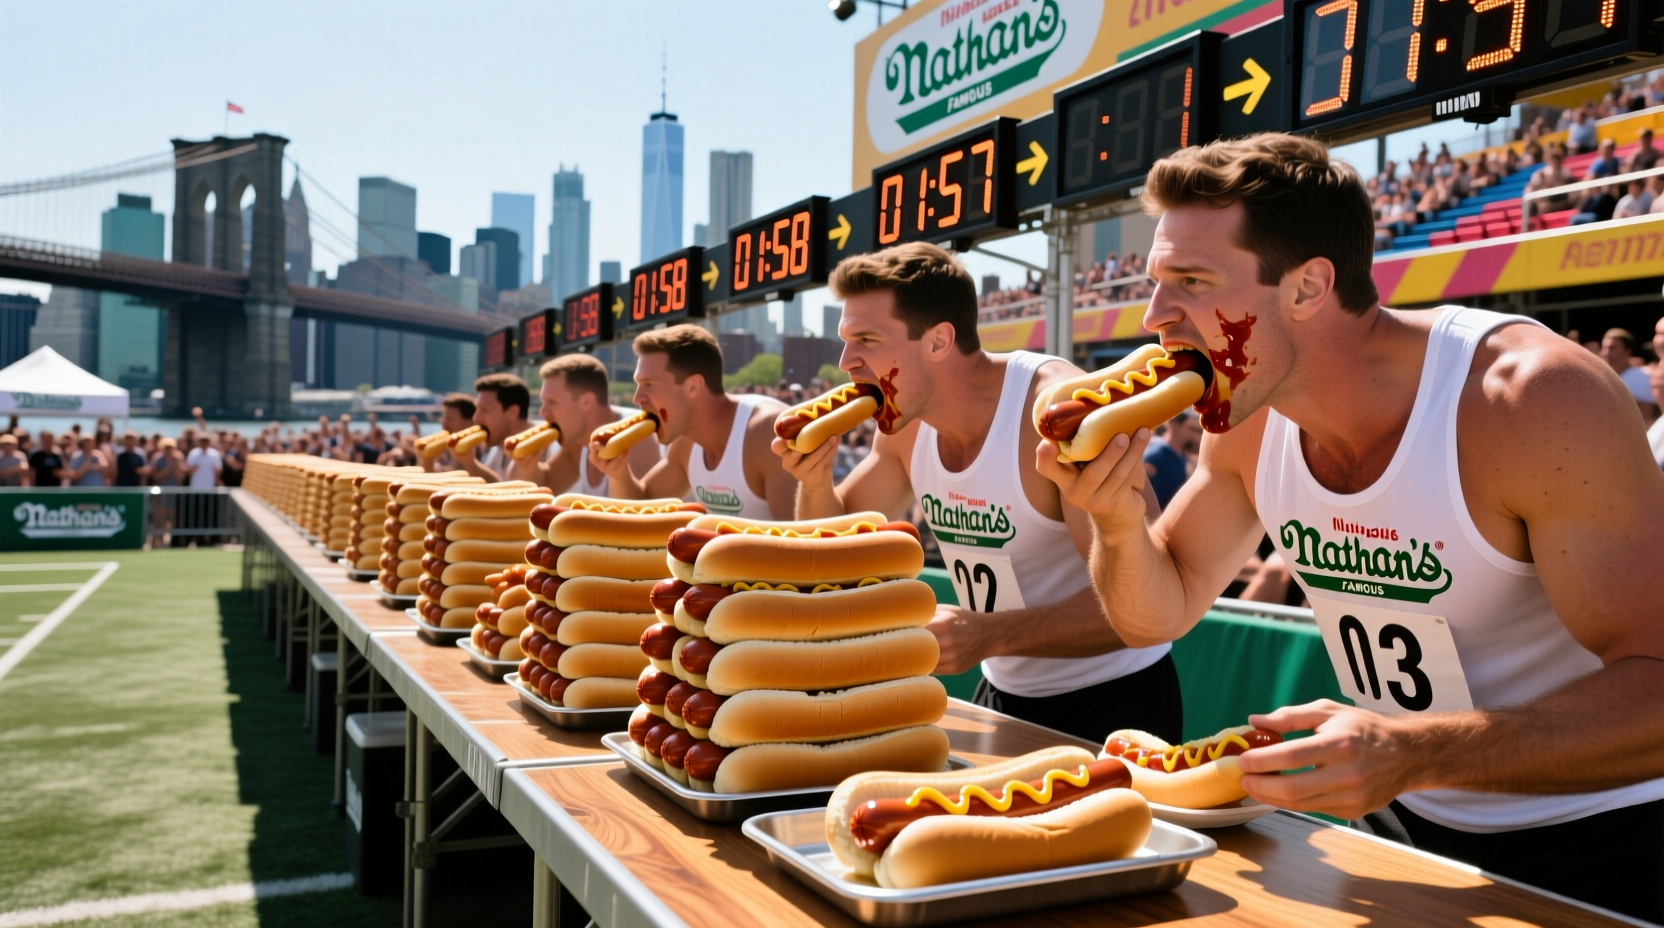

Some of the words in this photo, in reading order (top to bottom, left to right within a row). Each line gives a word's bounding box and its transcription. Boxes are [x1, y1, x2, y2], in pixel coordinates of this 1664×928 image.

[885, 0, 1060, 106] Nathans
[946, 81, 993, 114] FAMOUS
[879, 139, 995, 244] 01:57
[733, 211, 811, 291] 01:58
[632, 258, 688, 321] 01:58
[13, 502, 123, 528] Nathan's
[922, 493, 1011, 533] Nathan's
[1279, 519, 1443, 582] Nathan's
